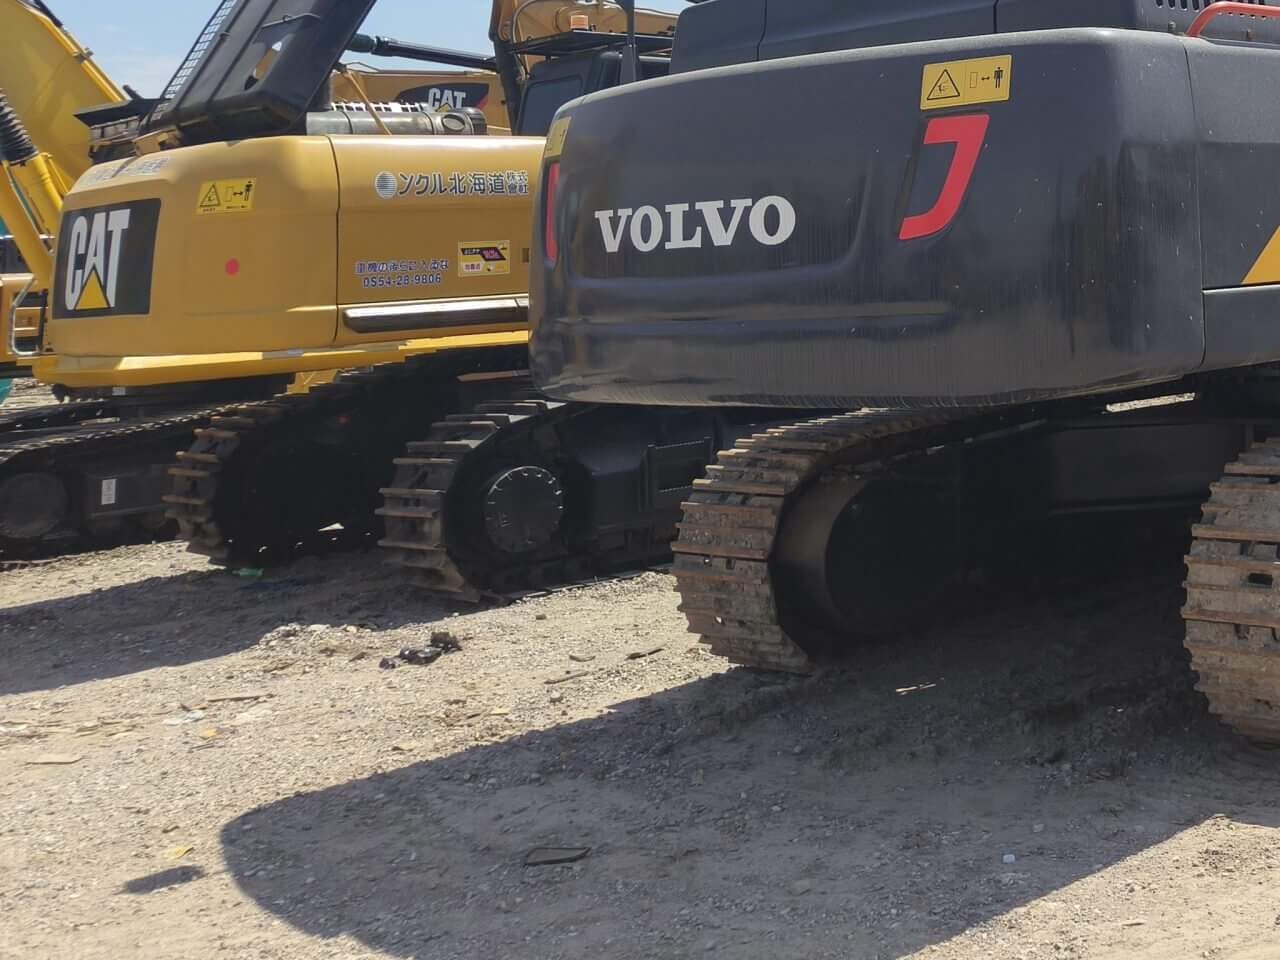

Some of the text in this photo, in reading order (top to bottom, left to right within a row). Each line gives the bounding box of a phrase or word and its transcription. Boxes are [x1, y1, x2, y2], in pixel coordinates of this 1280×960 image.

[428, 87, 466, 112] CAT
[594, 195, 796, 253] VOLVO
[65, 208, 131, 311] CAT
